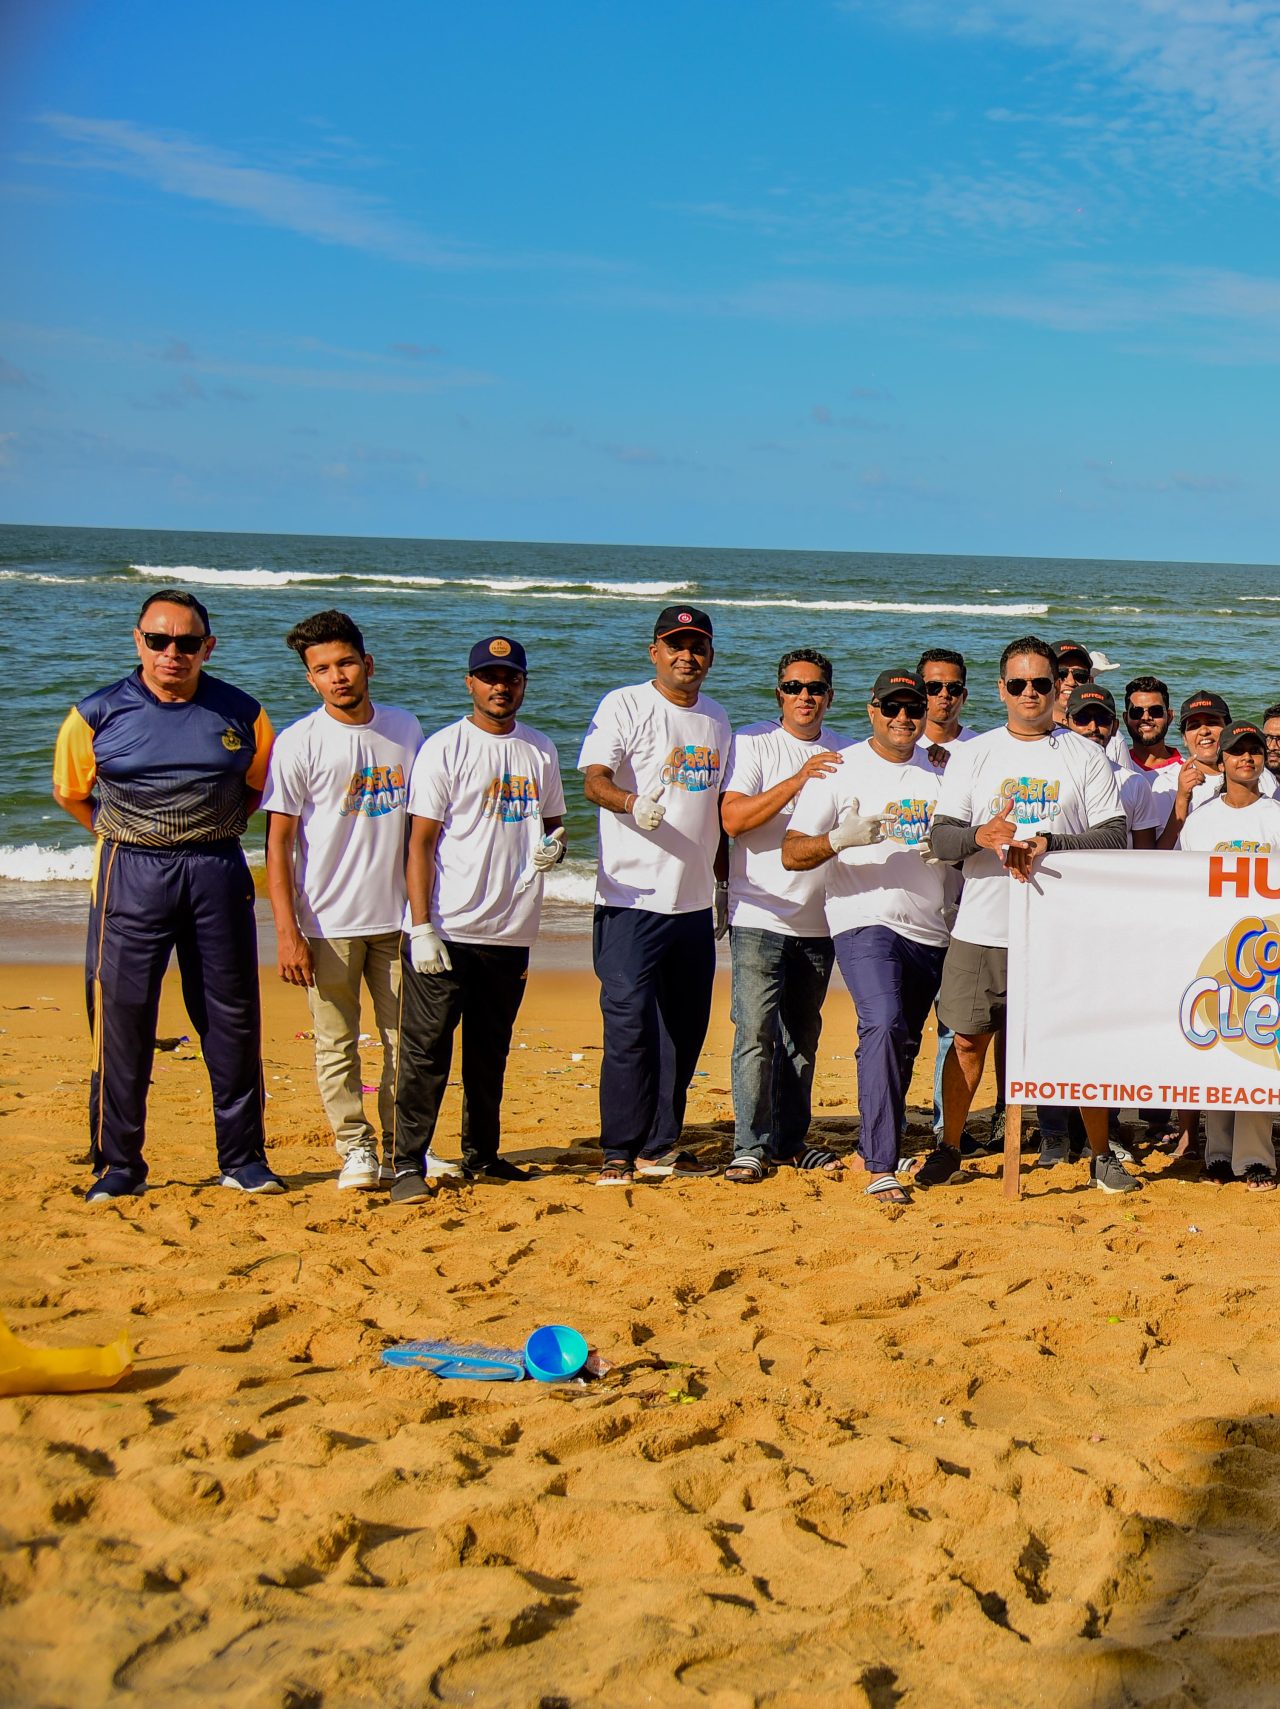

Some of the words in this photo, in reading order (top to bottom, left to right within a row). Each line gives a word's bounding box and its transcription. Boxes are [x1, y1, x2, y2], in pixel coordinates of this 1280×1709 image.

[890, 677, 915, 686] HUTCH
[1081, 692, 1105, 701] HUTCH
[1189, 700, 1212, 709] HUTCH
[1010, 1081, 1152, 1102] PROTECTING
[1159, 1085, 1200, 1103] THE
